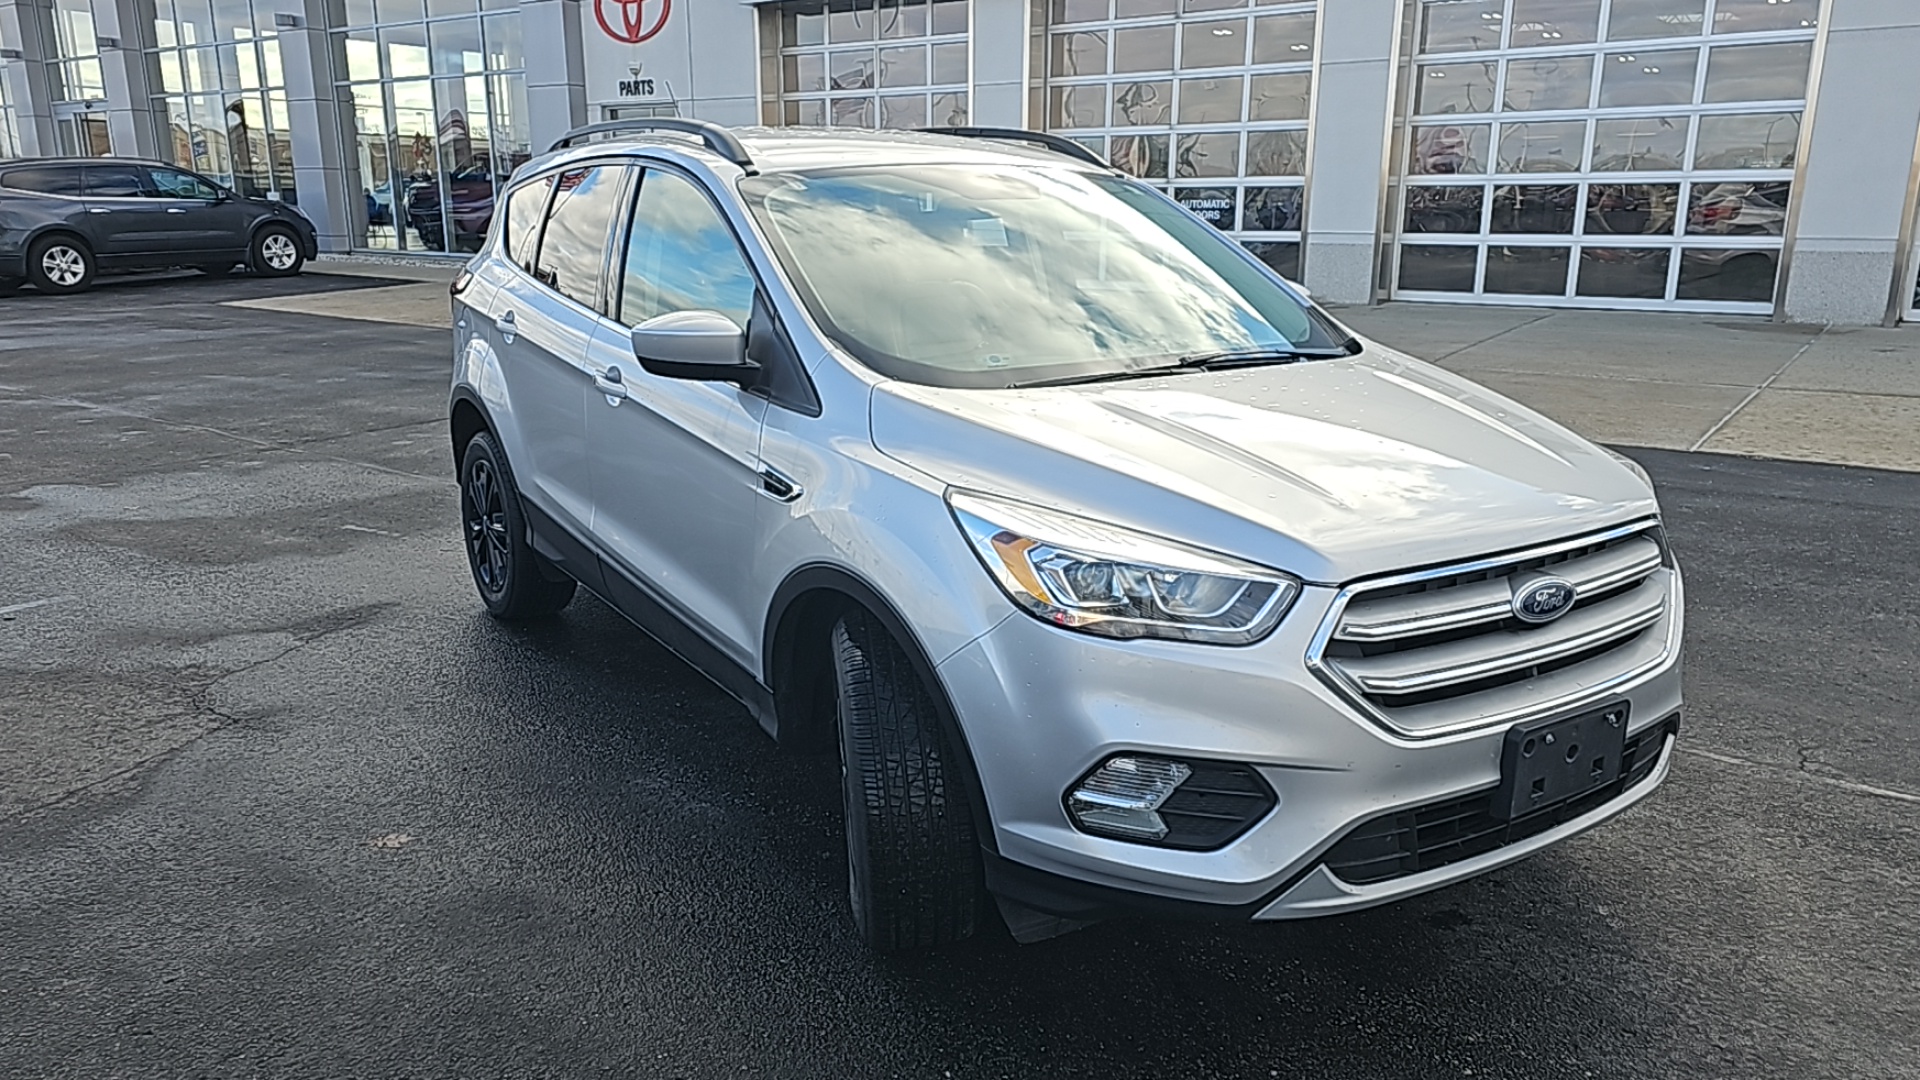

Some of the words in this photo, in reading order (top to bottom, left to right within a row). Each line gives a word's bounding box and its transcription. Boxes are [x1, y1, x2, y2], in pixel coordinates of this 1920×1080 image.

[619, 79, 654, 97] PARTS
[1180, 198, 1230, 209] AUTOMATIC
[1194, 209, 1221, 220] OORS
[1533, 587, 1565, 613] Ford
